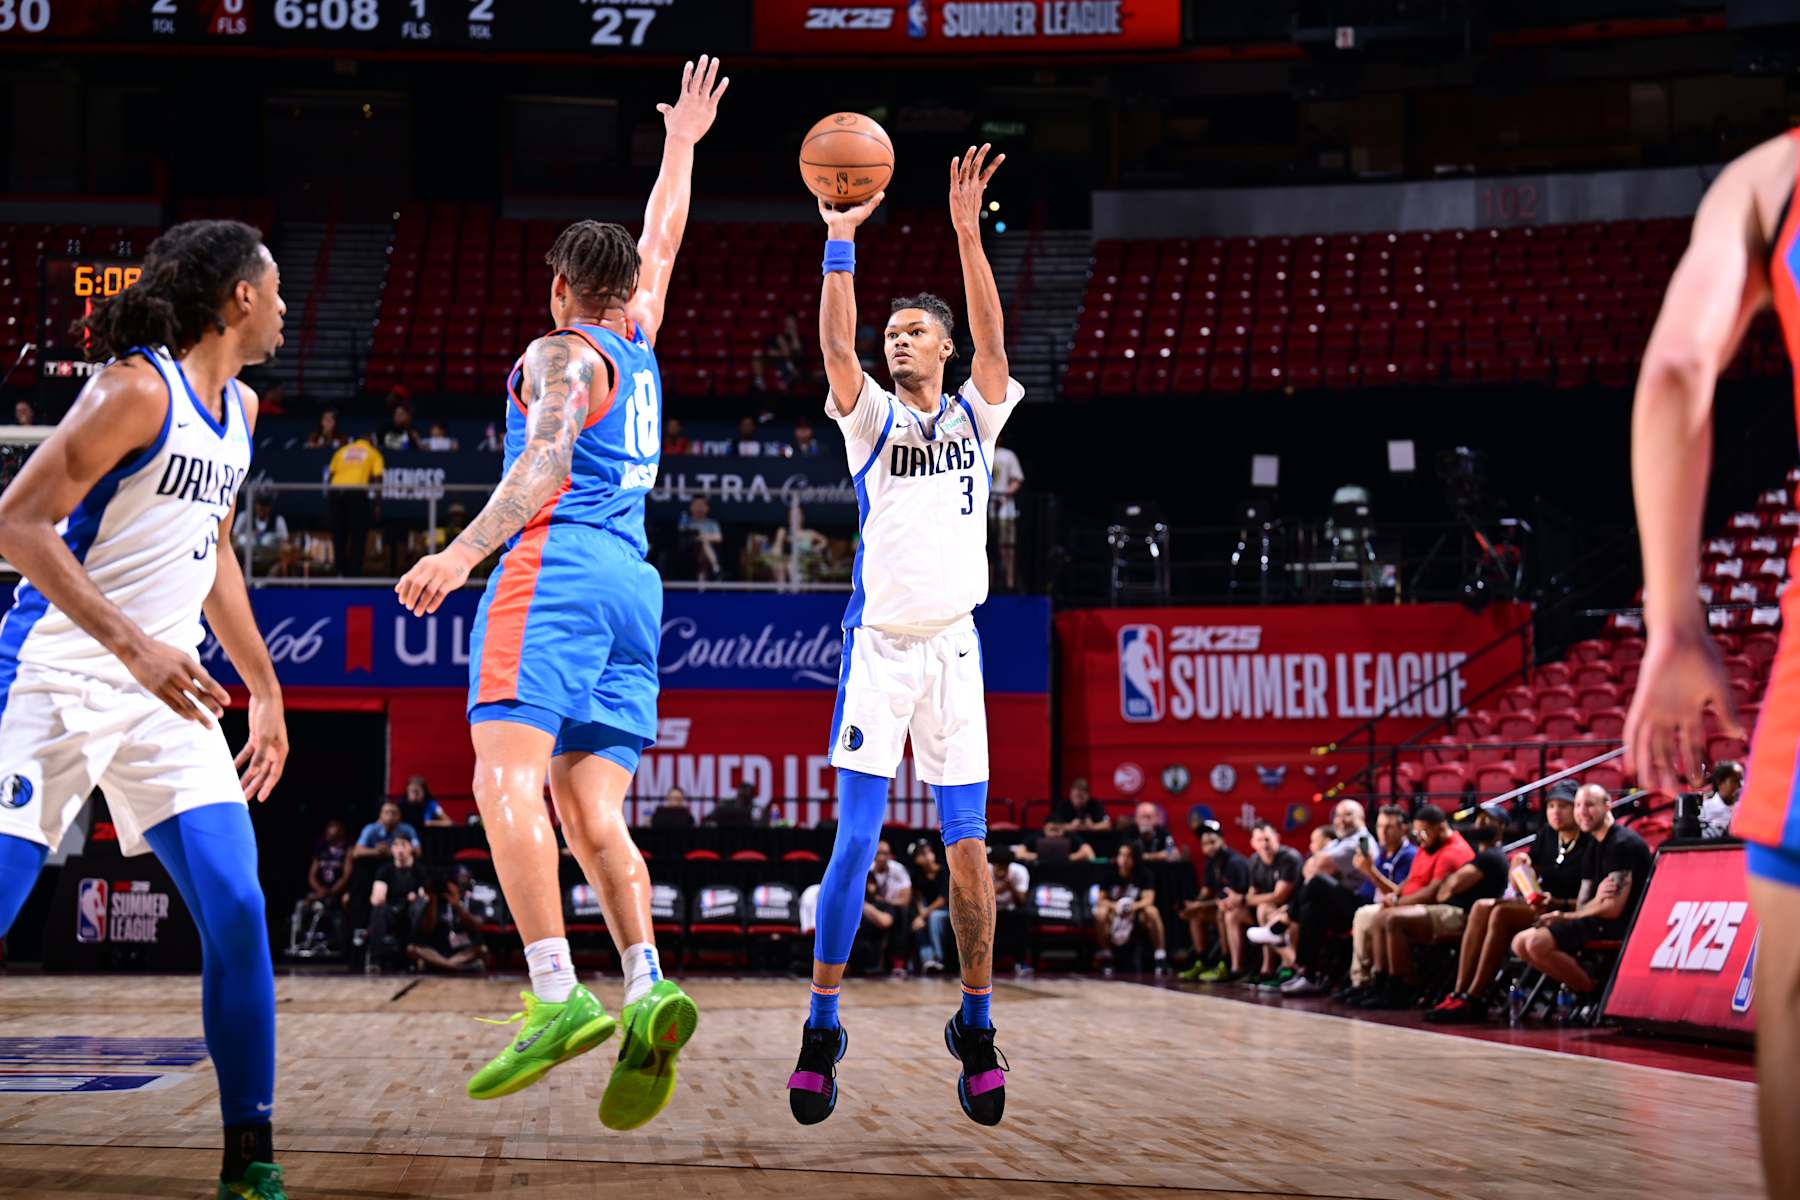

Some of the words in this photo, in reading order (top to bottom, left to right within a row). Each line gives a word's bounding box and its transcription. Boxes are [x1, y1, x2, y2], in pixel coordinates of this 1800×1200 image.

[217, 17, 247, 34] FLS
[273, 0, 379, 30] 6:08
[402, 21, 431, 39] FLS
[590, 7, 657, 46] 27
[805, 8, 893, 29] 2K25
[942, 2, 1036, 37] SUMMER
[1043, 1, 1122, 35] LEAGUE
[1480, 185, 1537, 219] 102
[890, 438, 975, 477] DALLAS
[960, 476, 974, 515] 3
[658, 617, 842, 685] Courtside
[1168, 626, 1262, 651] 2K25
[1169, 654, 1329, 719] SUMMER
[1335, 652, 1467, 718] LEAGUE
[111, 892, 169, 919] SUMMER
[110, 917, 159, 942] LEAGUE
[1650, 901, 1749, 972] 2K25
